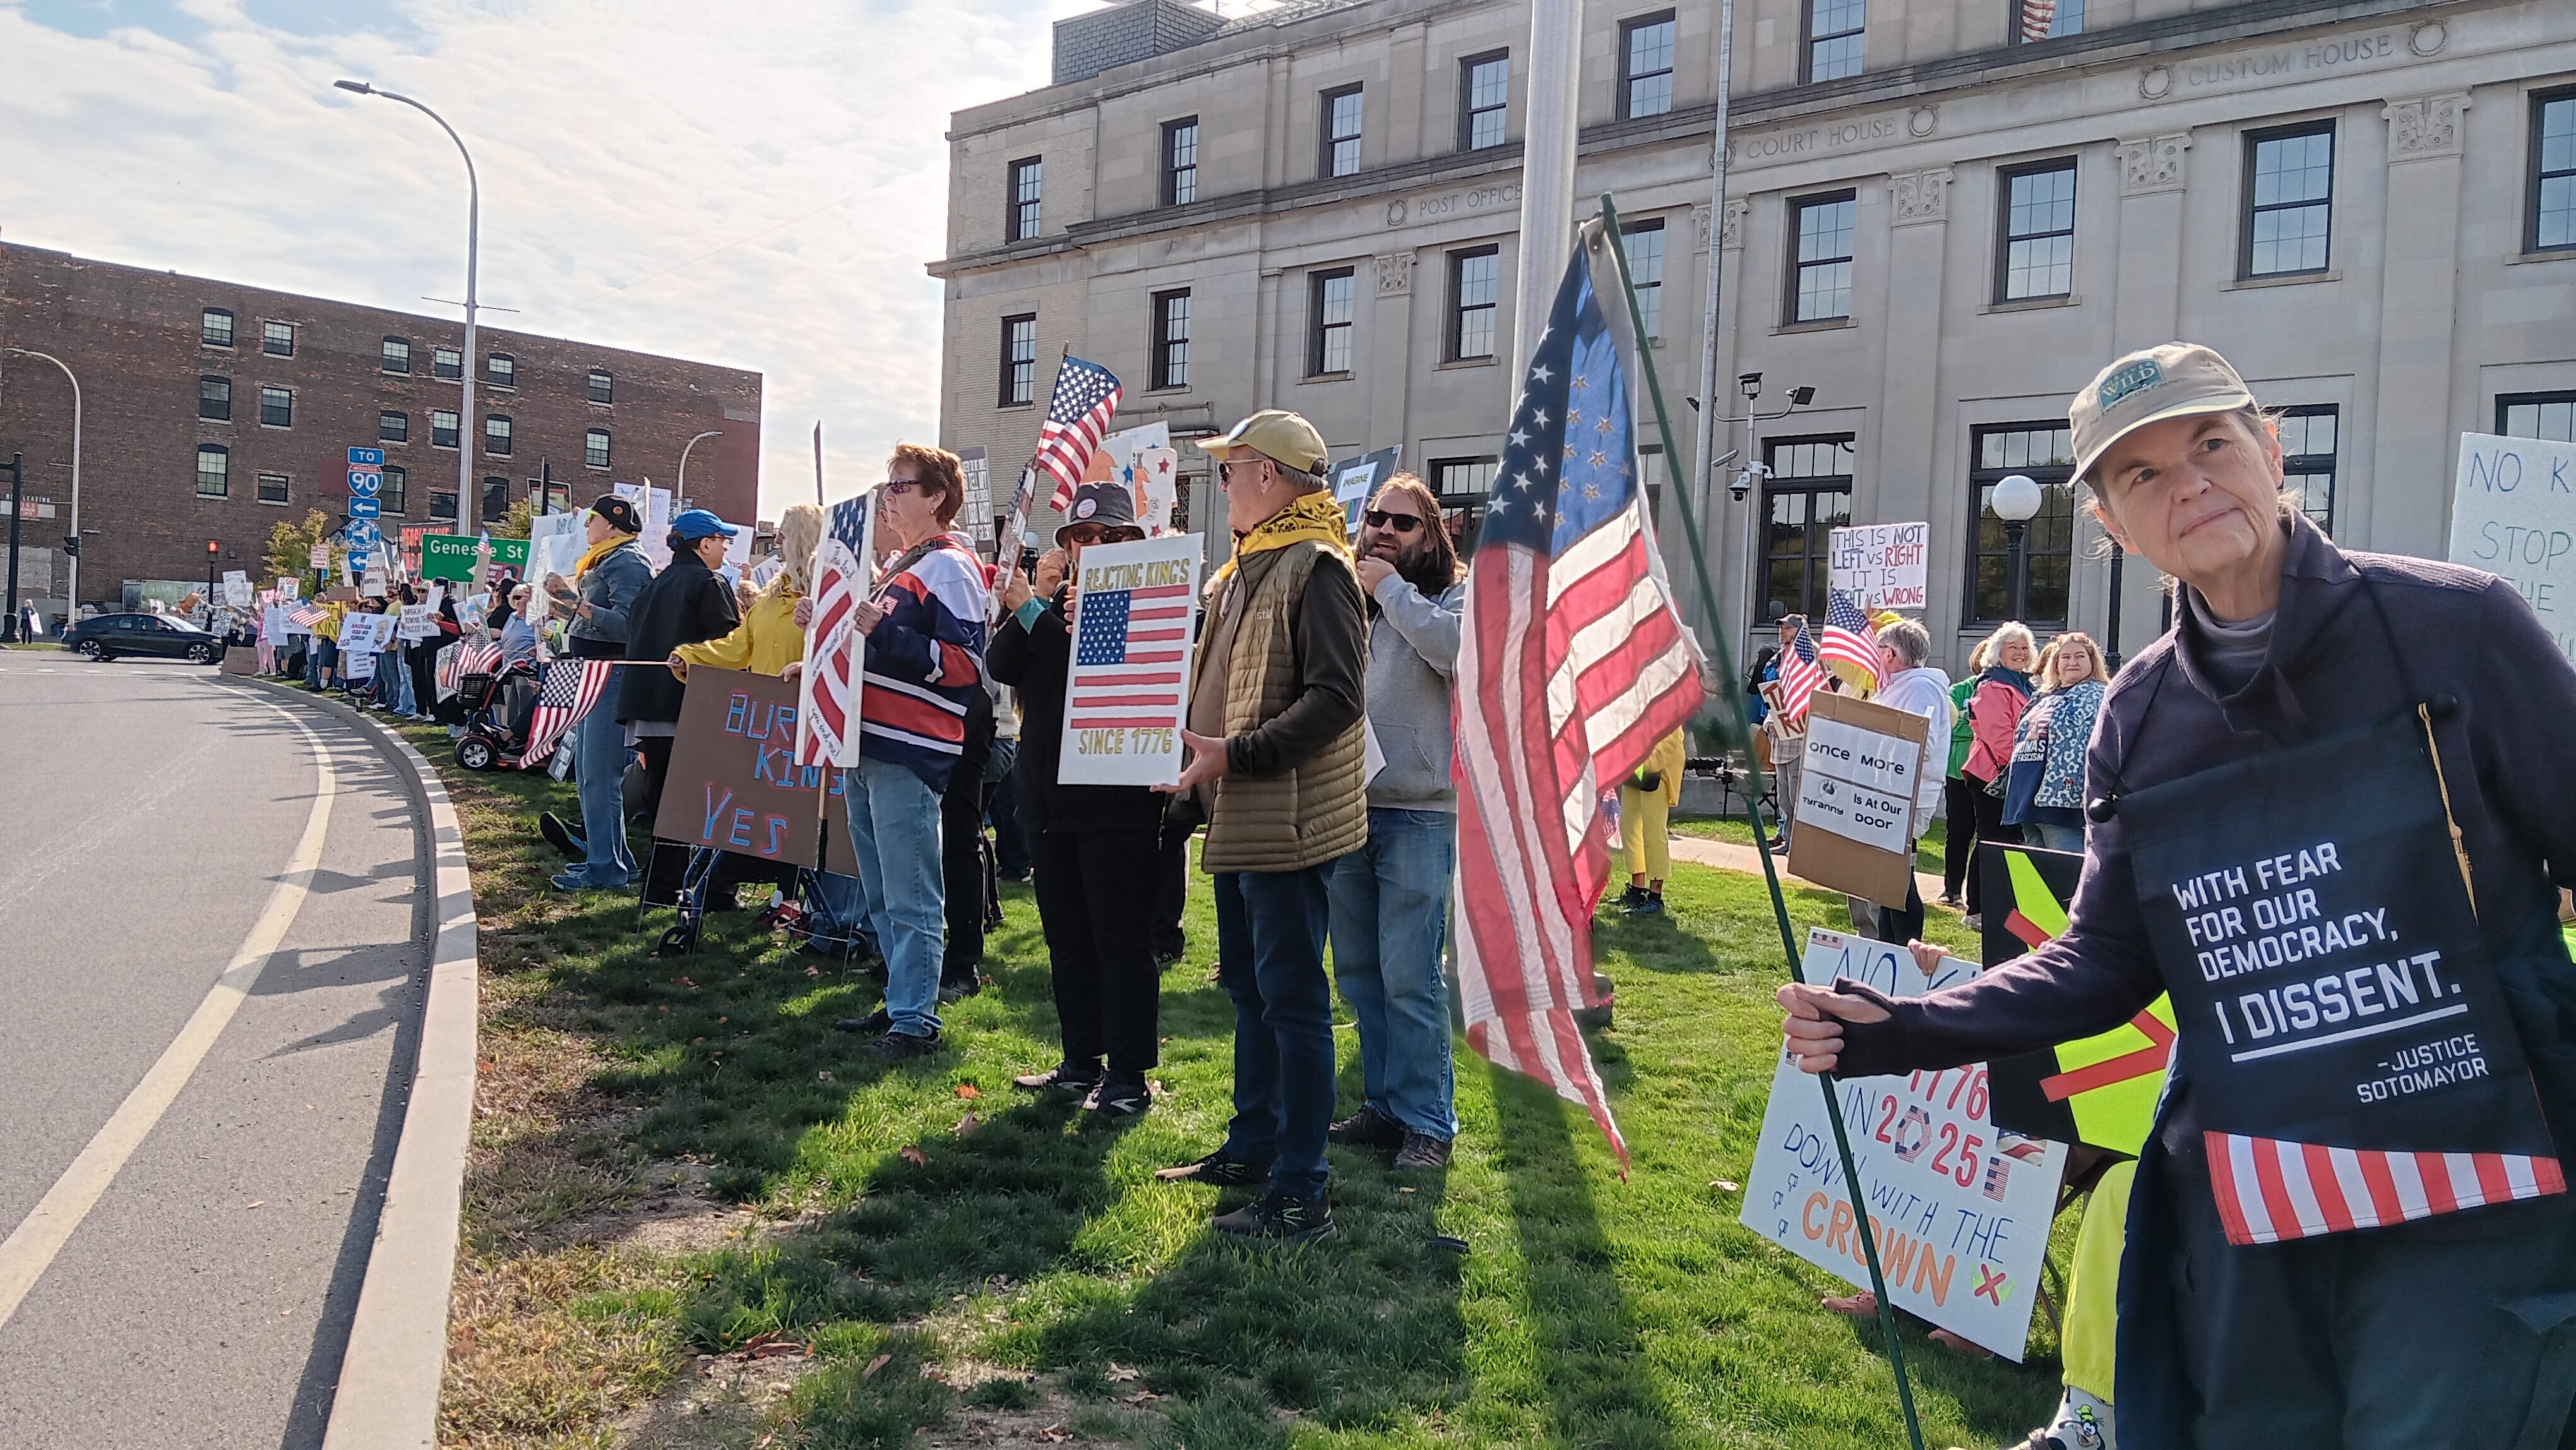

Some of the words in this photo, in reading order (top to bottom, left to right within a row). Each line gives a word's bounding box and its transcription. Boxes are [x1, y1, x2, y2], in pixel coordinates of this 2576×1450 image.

[2188, 52, 2291, 87] CUSTOM
[2304, 34, 2394, 69] HOUSE
[1747, 129, 1818, 159] COURT
[1828, 117, 1896, 147] HOUSE
[1419, 195, 1458, 217] POST
[1467, 185, 1522, 208] OFFICE
[2102, 367, 2156, 397] WILD
[357, 451, 375, 462] TO
[2469, 450, 2522, 492] NO
[352, 472, 379, 491] 90
[1343, 474, 1369, 488] IMAGINE
[348, 519, 360, 532] NEW
[362, 519, 379, 532] YORK
[1832, 530, 1864, 548] THIS
[1870, 529, 1885, 546] IS
[1893, 525, 1925, 544] NOT
[349, 537, 378, 551] THRUWAY
[430, 539, 498, 558] Genese
[506, 544, 523, 560] St
[1832, 548, 1864, 570] LEFT
[1885, 544, 1923, 567] RIGHT
[2473, 521, 2572, 570] STOP
[1085, 563, 1143, 592] REJCTING
[1145, 558, 1190, 587] KINGS
[1851, 571, 1871, 587] IT
[1881, 568, 1896, 586] IS
[1883, 586, 1923, 606] WRONG
[2500, 576, 2555, 612] HE
[1078, 729, 1124, 754] SINCE
[1131, 728, 1172, 754] 1776
[1861, 755, 1905, 775] More
[1803, 796, 1844, 815] Tyranny
[1854, 793, 1862, 805] Is
[1865, 798, 1878, 810] At
[1881, 801, 1902, 815] Our
[703, 786, 788, 855] YES
[2172, 866, 2250, 911] WITH
[2255, 842, 2342, 890] FEAR
[2185, 907, 2247, 947] FOR
[2252, 888, 2321, 930] OUR
[2197, 907, 2399, 981] DEMOCRACY,
[2215, 1001, 2235, 1044] I
[2239, 950, 2462, 1040] DISSENT.
[2356, 1057, 2490, 1103] SOTOMAYOR
[1842, 1084, 1876, 1135] IN
[1784, 1123, 1867, 1185] DOWN
[1871, 1178, 1939, 1236] WITH
[1952, 1209, 2013, 1264] THE
[1803, 1192, 1955, 1307] CROWN
